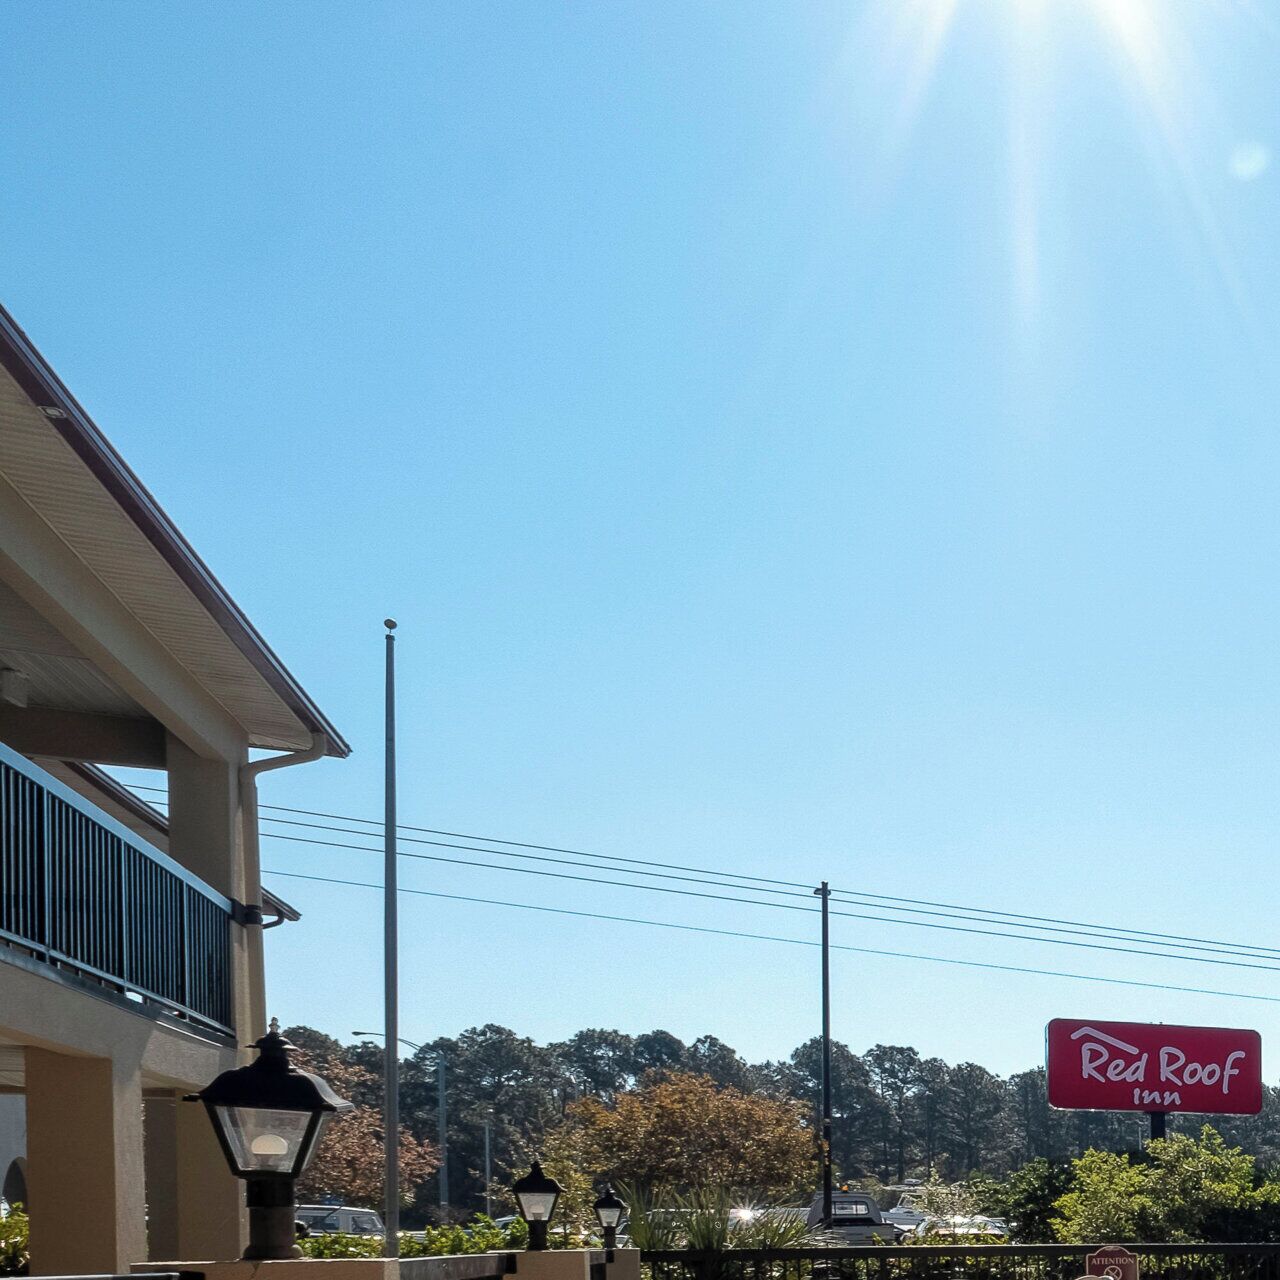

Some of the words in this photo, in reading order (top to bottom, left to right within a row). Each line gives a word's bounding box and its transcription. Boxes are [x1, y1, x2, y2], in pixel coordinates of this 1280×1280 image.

[1081, 1042, 1148, 1083] Red
[1159, 1046, 1246, 1094] Roof
[1092, 1257, 1134, 1265] ATTENTION
